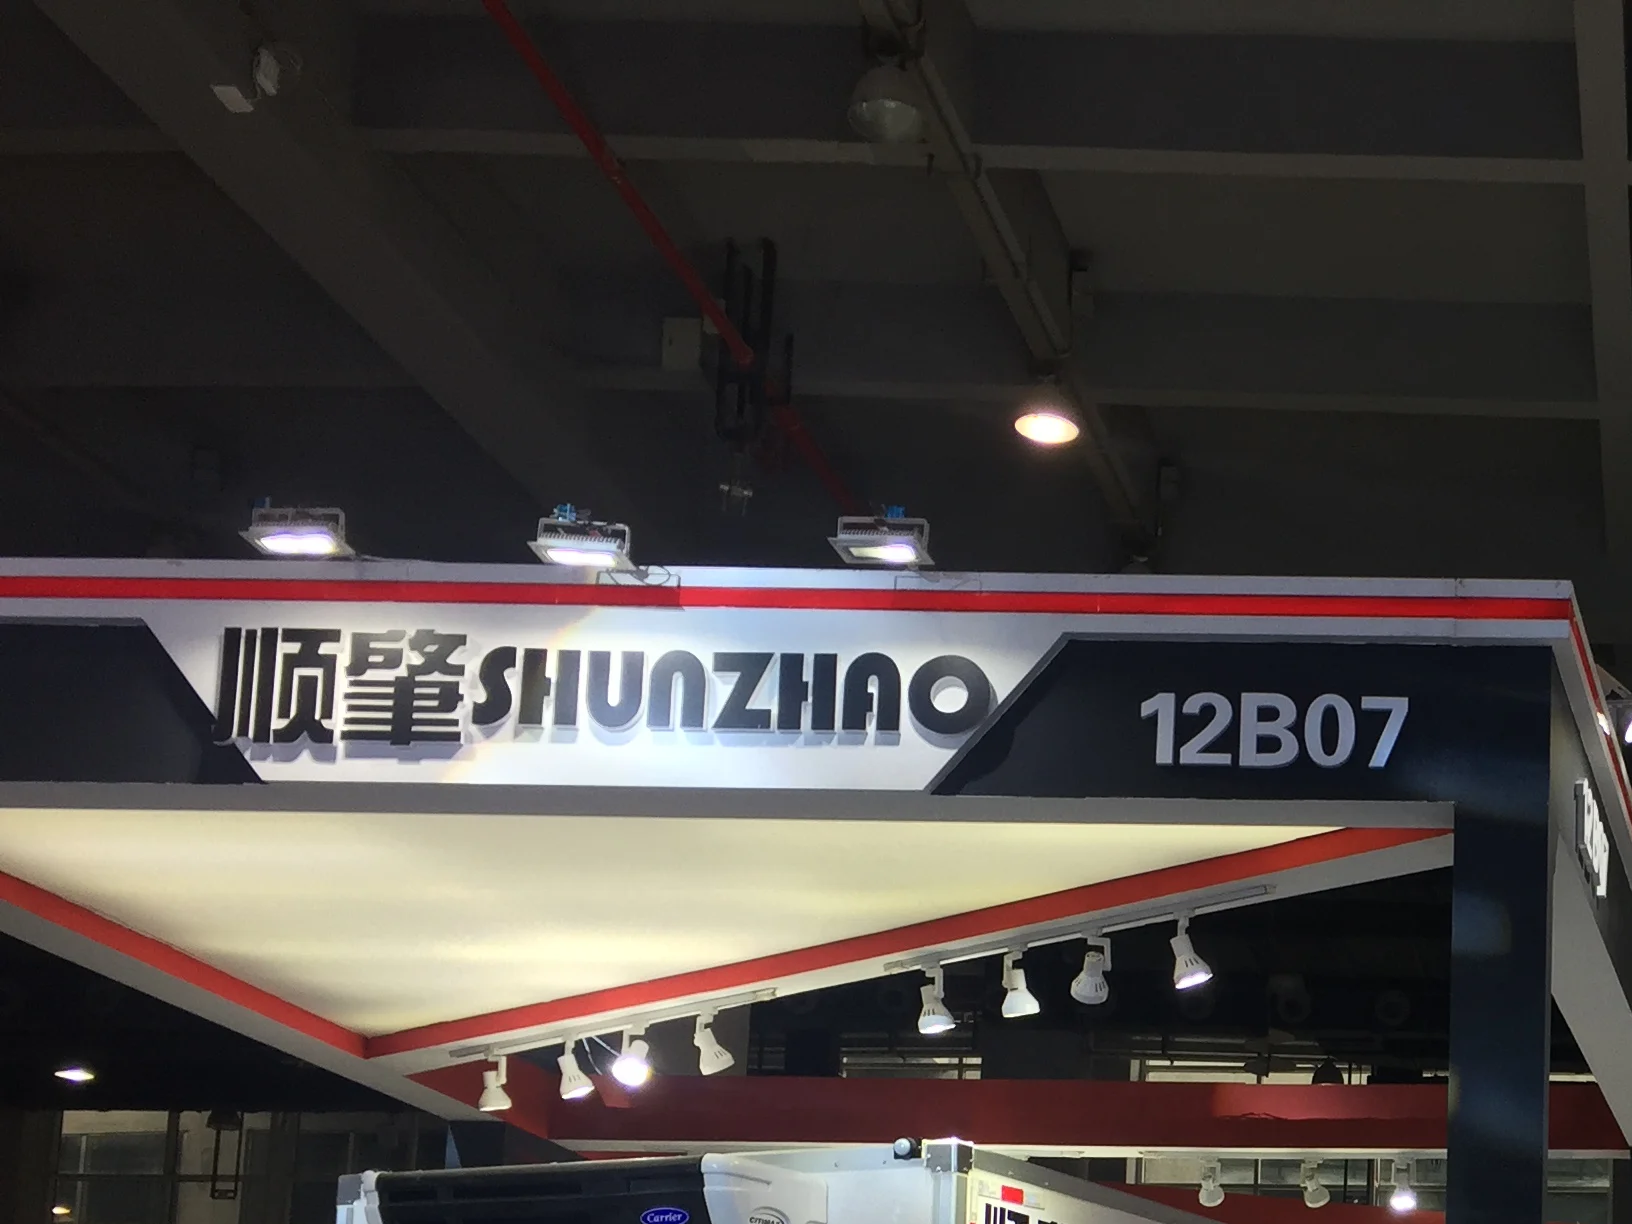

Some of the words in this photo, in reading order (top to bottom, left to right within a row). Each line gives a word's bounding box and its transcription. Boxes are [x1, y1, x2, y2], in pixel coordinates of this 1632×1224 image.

[212, 626, 465, 746] 顺肇
[471, 645, 992, 734] SHUNZHAO
[1140, 691, 1409, 768] 12B07
[646, 1213, 683, 1223] Carrier
